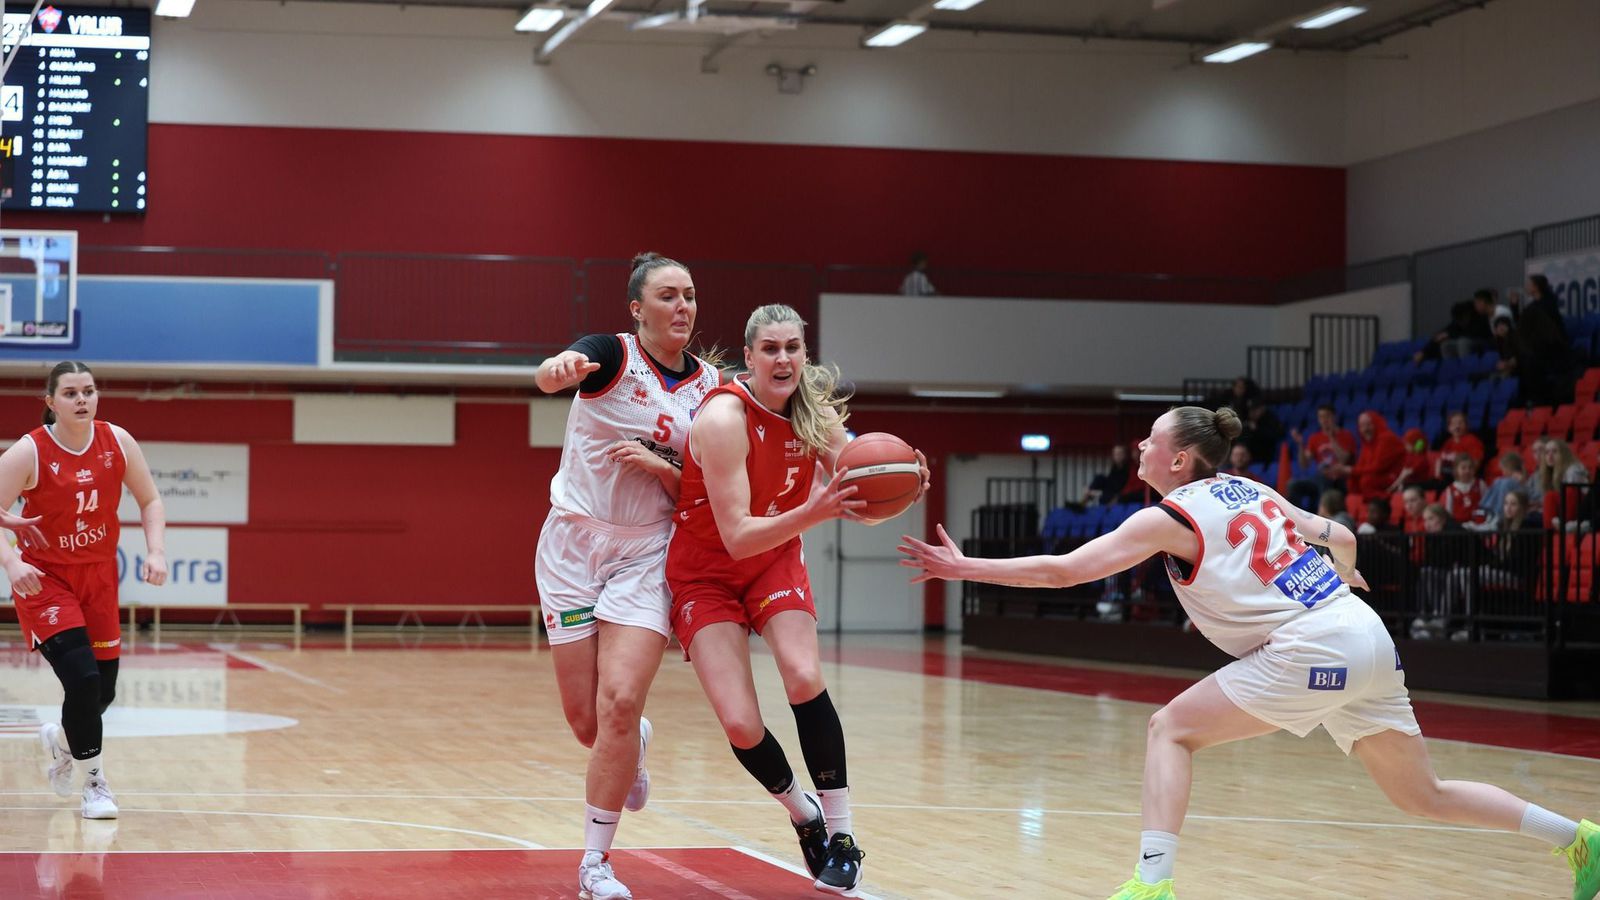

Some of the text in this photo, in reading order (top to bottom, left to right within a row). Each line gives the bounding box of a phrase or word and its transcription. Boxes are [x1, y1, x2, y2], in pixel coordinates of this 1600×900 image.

[67, 15, 122, 36] VALUR
[653, 413, 674, 442] 5
[777, 466, 800, 497] 5
[75, 489, 99, 514] 14
[135, 552, 223, 584] trra
[564, 611, 594, 624] SUBWA
